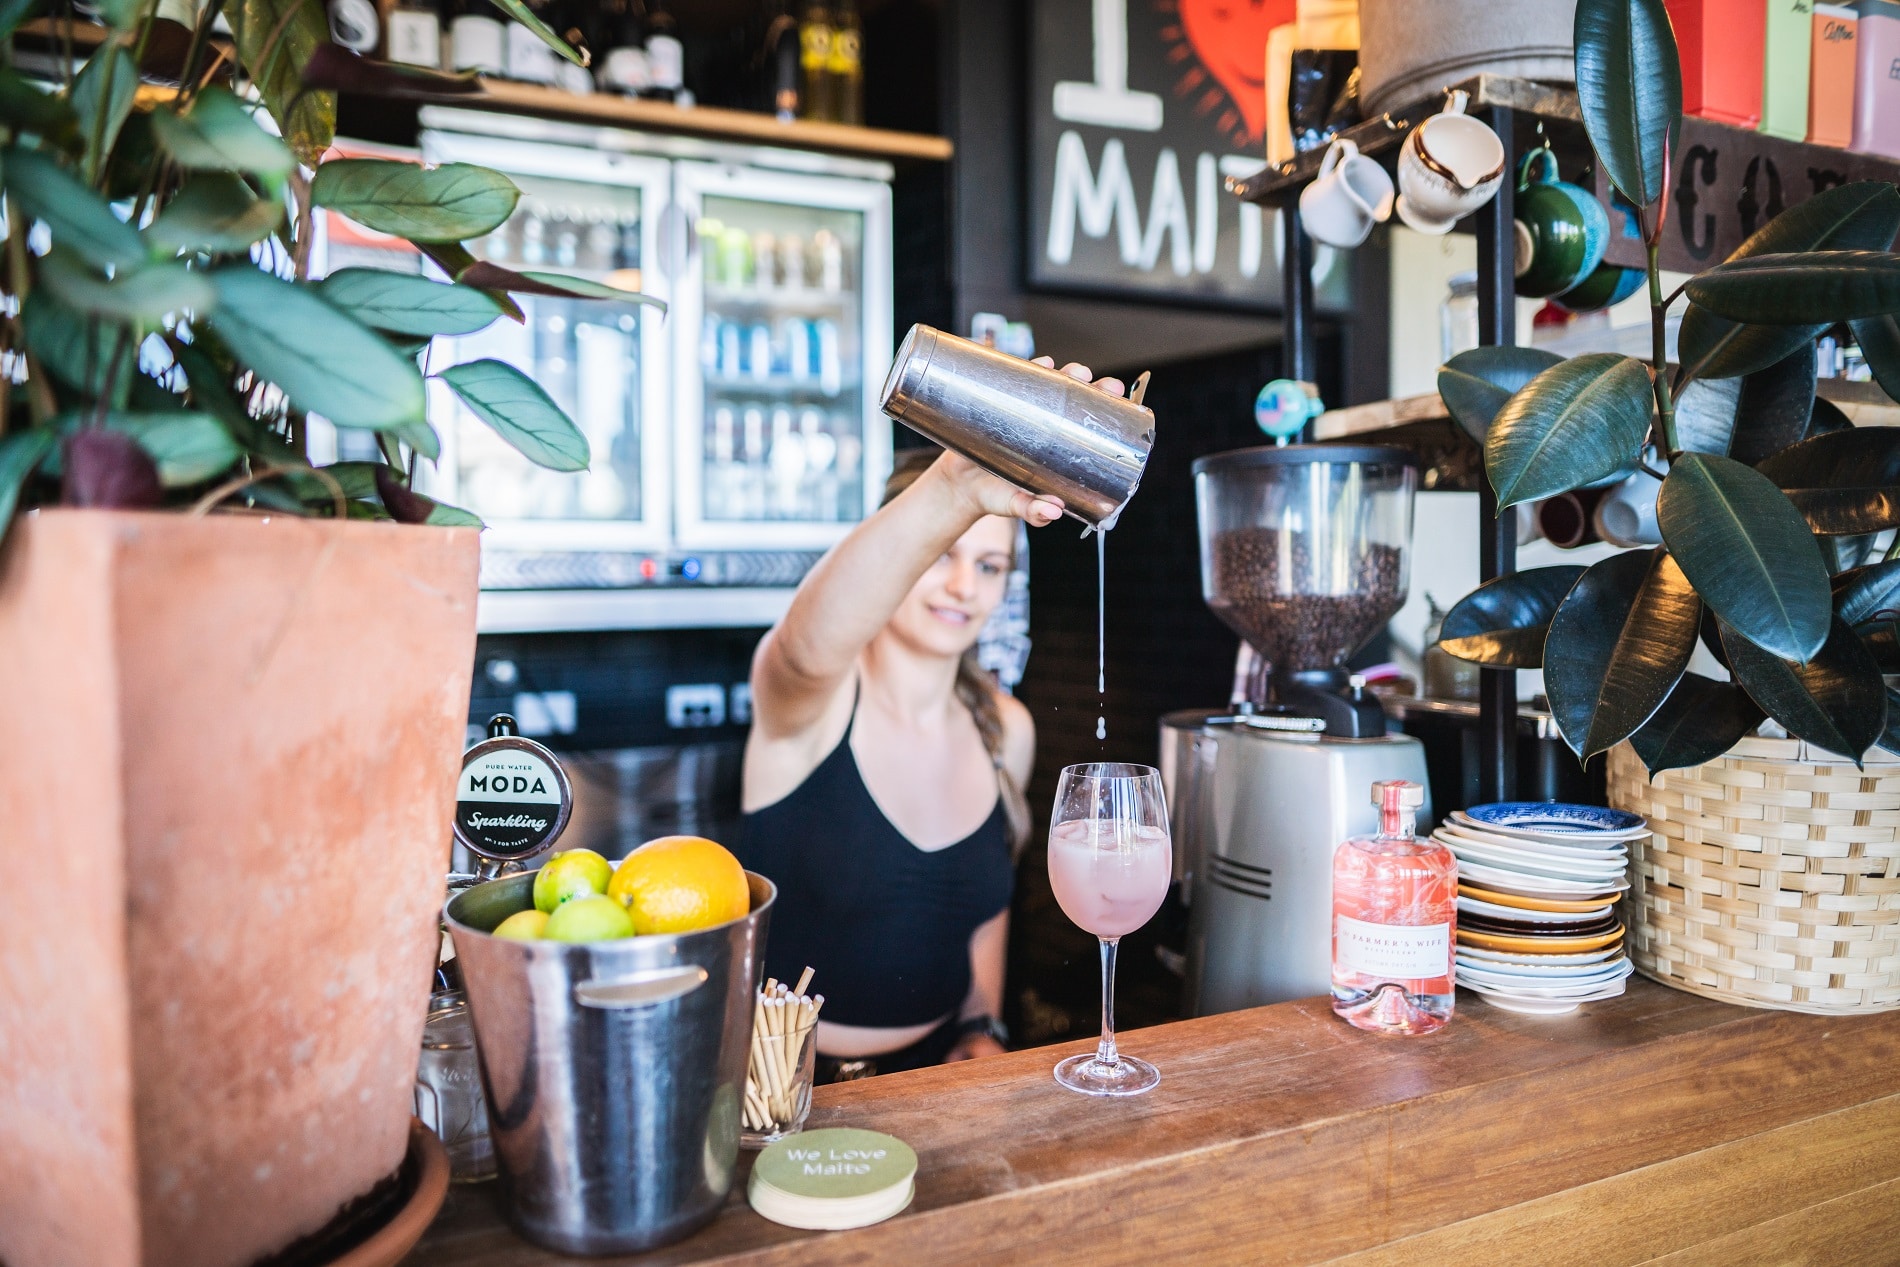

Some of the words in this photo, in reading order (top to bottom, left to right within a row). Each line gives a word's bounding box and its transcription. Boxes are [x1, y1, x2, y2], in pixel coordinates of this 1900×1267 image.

[1053, 0, 1163, 131] I
[470, 775, 547, 794] MODA
[467, 811, 547, 832] Sparkling
[1353, 934, 1409, 947] FARMER'S
[1417, 939, 1442, 947] WIFE
[787, 1149, 821, 1161] We
[829, 1148, 887, 1161] Love
